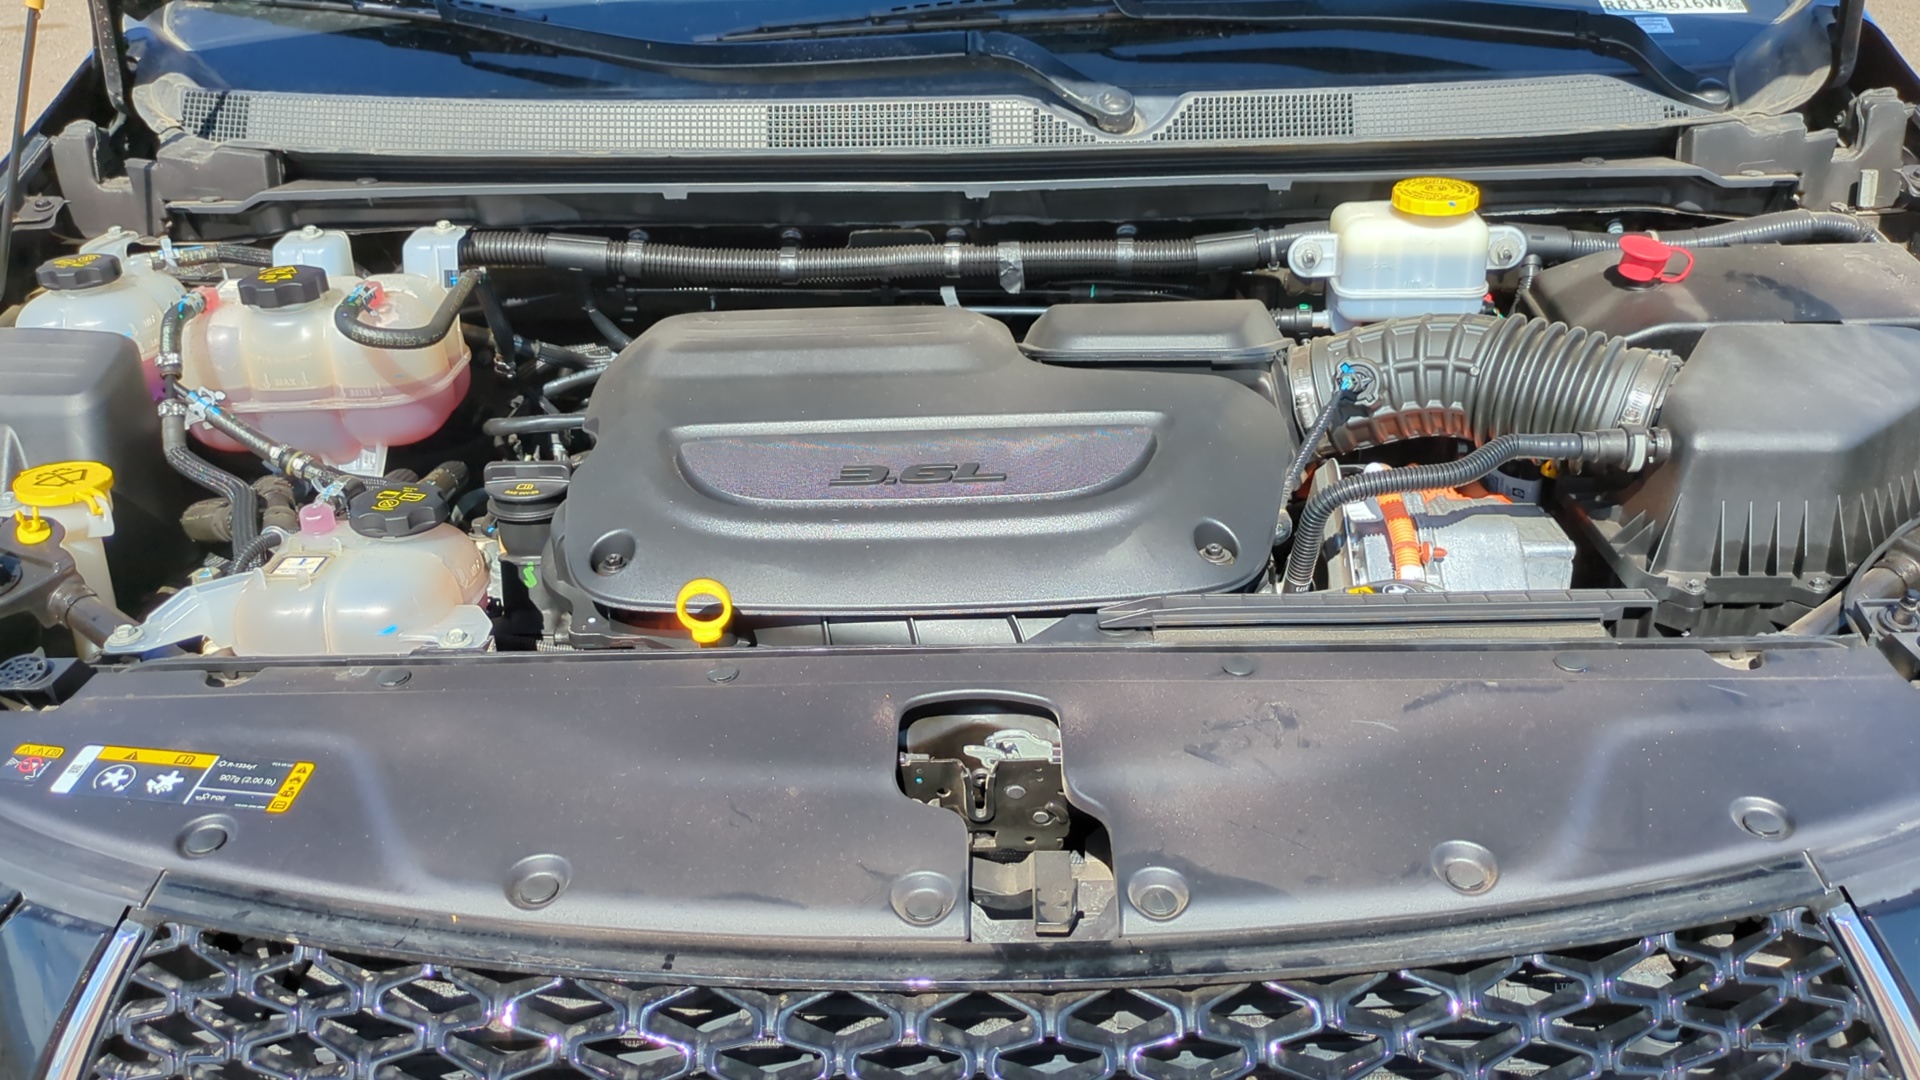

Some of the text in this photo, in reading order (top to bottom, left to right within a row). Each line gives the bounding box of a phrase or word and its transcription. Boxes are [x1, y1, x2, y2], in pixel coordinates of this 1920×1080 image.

[829, 462, 1007, 486] 3.6L
[227, 762, 257, 770] R-1234yf
[219, 773, 277, 787] 907g (2.00 lb)
[210, 794, 227, 802] POE
